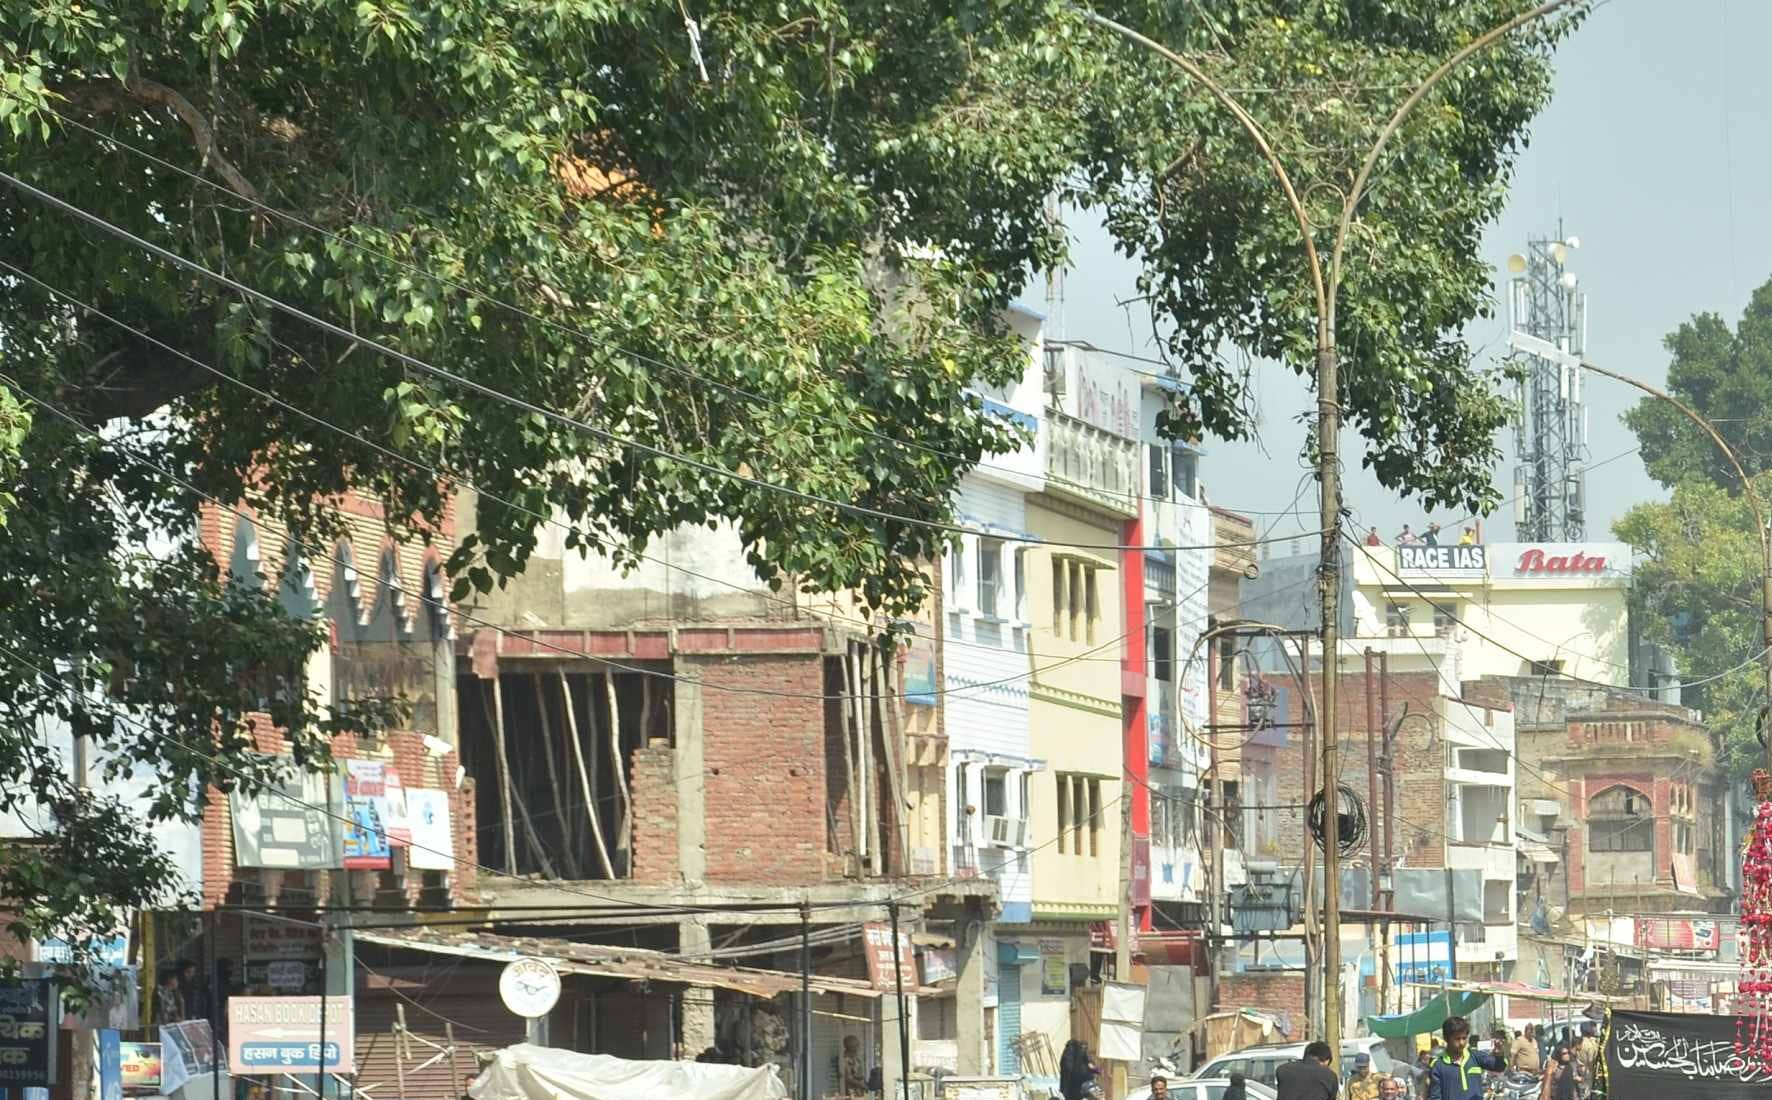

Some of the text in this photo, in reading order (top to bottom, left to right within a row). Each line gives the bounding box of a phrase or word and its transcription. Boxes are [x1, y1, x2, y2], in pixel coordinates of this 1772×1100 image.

[1402, 547, 1484, 569] RACE IAS
[1514, 549, 1607, 574] Bata
[236, 1003, 273, 1024] HASAN
